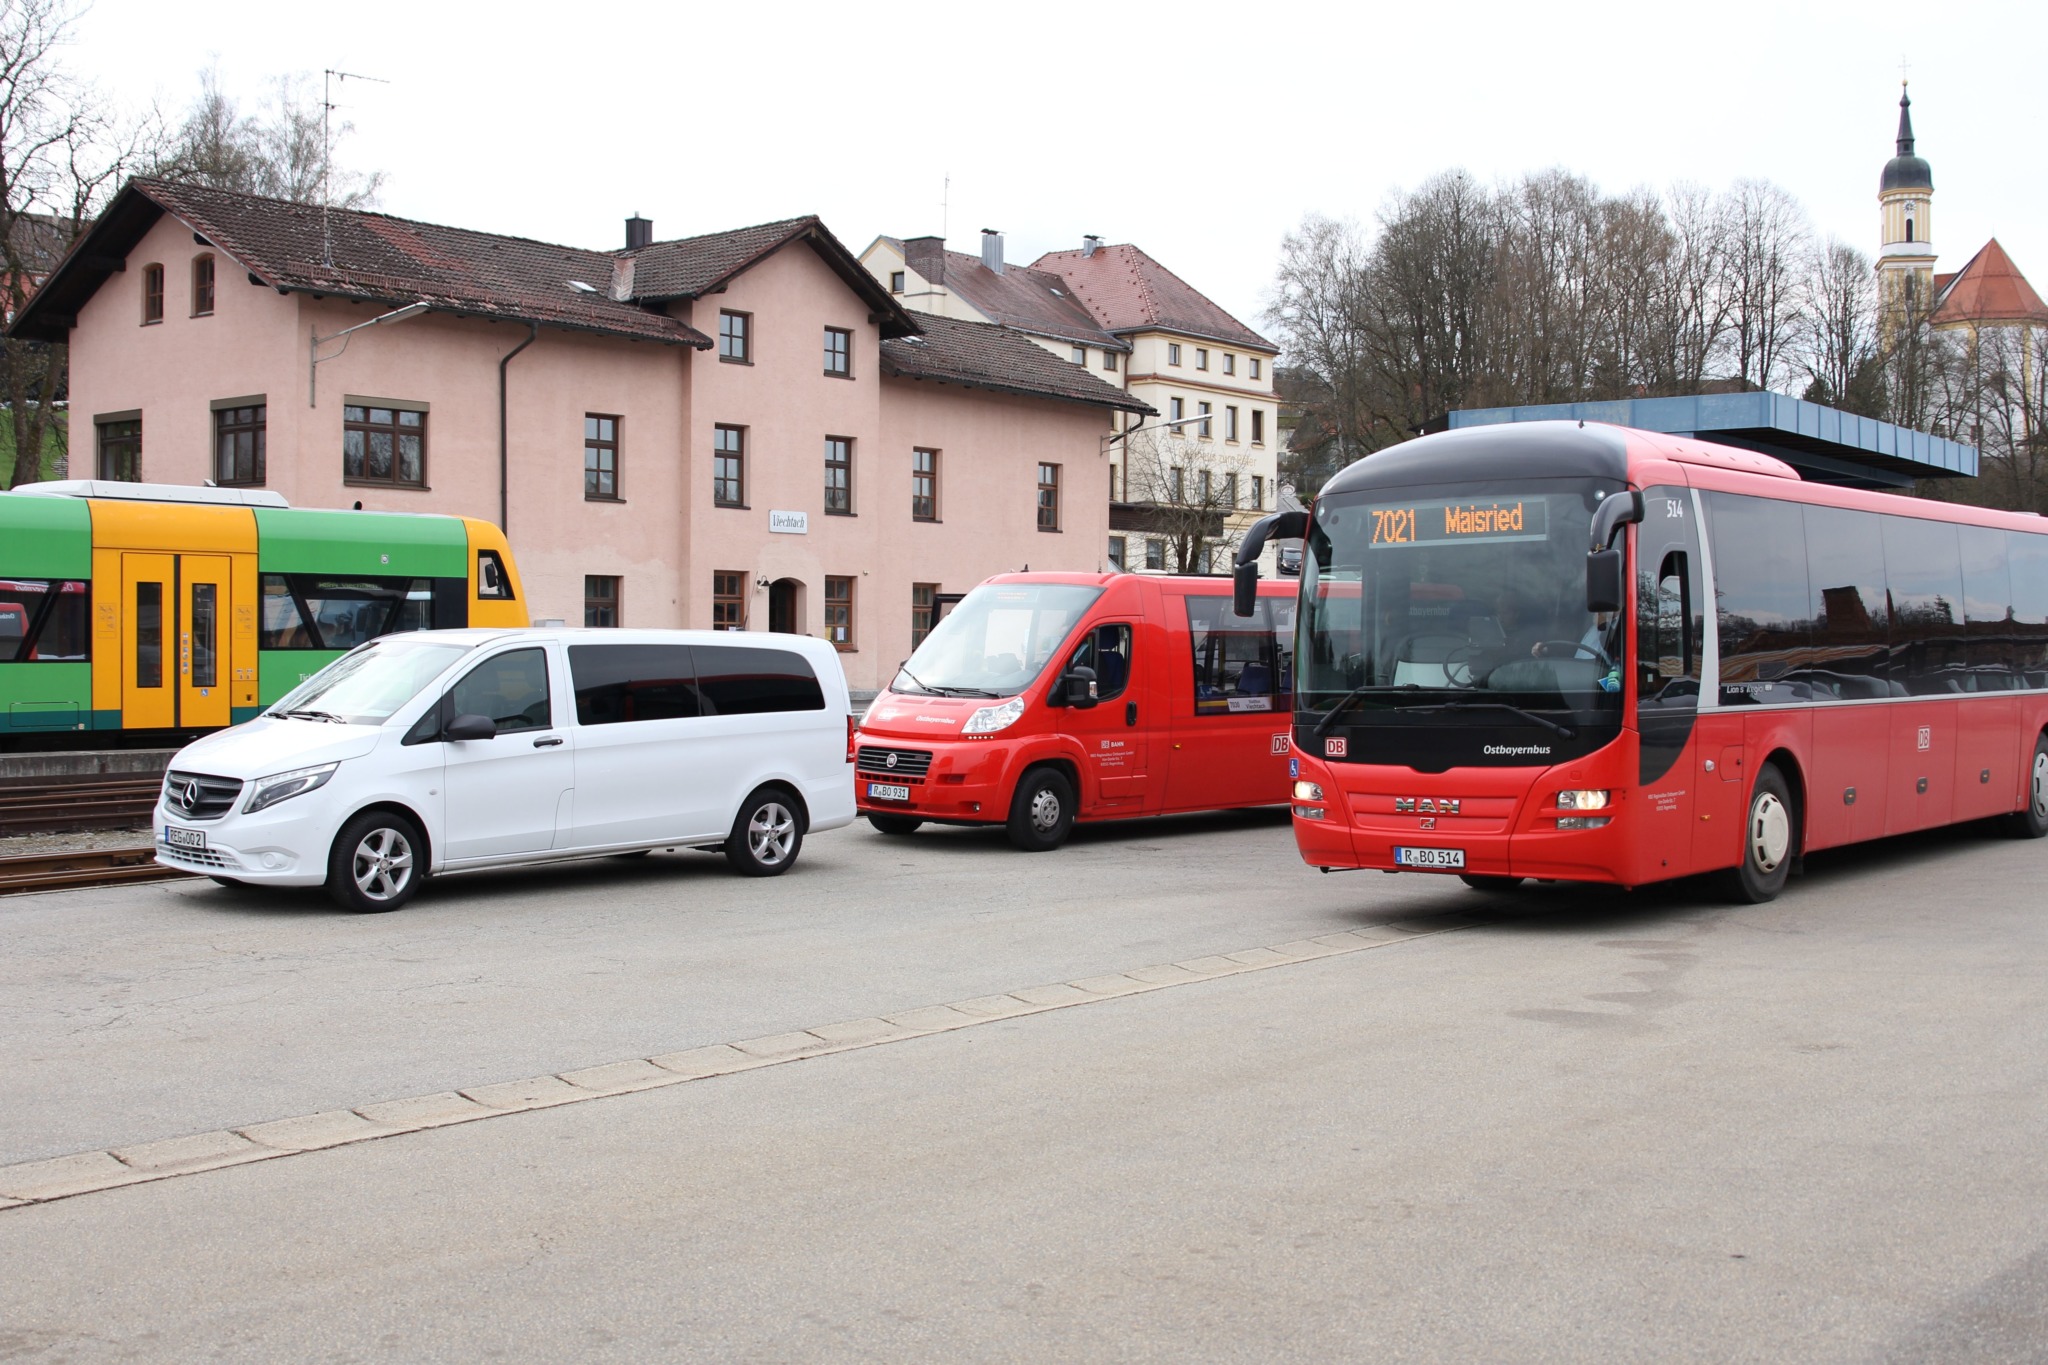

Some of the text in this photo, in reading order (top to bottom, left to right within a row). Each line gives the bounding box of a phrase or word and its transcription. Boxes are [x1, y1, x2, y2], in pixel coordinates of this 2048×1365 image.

[1667, 500, 1683, 517] 514
[773, 515, 805, 528] Viechtach
[1372, 502, 1522, 543] 7021 Maisried
[1273, 736, 1289, 752] DB
[1919, 729, 1929, 748] DB
[1327, 739, 1345, 754] DB
[1483, 744, 1551, 757] Ostbayernbus
[874, 786, 879, 795] R
[893, 788, 906, 798] 931
[1395, 797, 1460, 814] MAN
[170, 829, 182, 843] REG
[1405, 850, 1412, 862] R
[1438, 851, 1460, 864] 514
